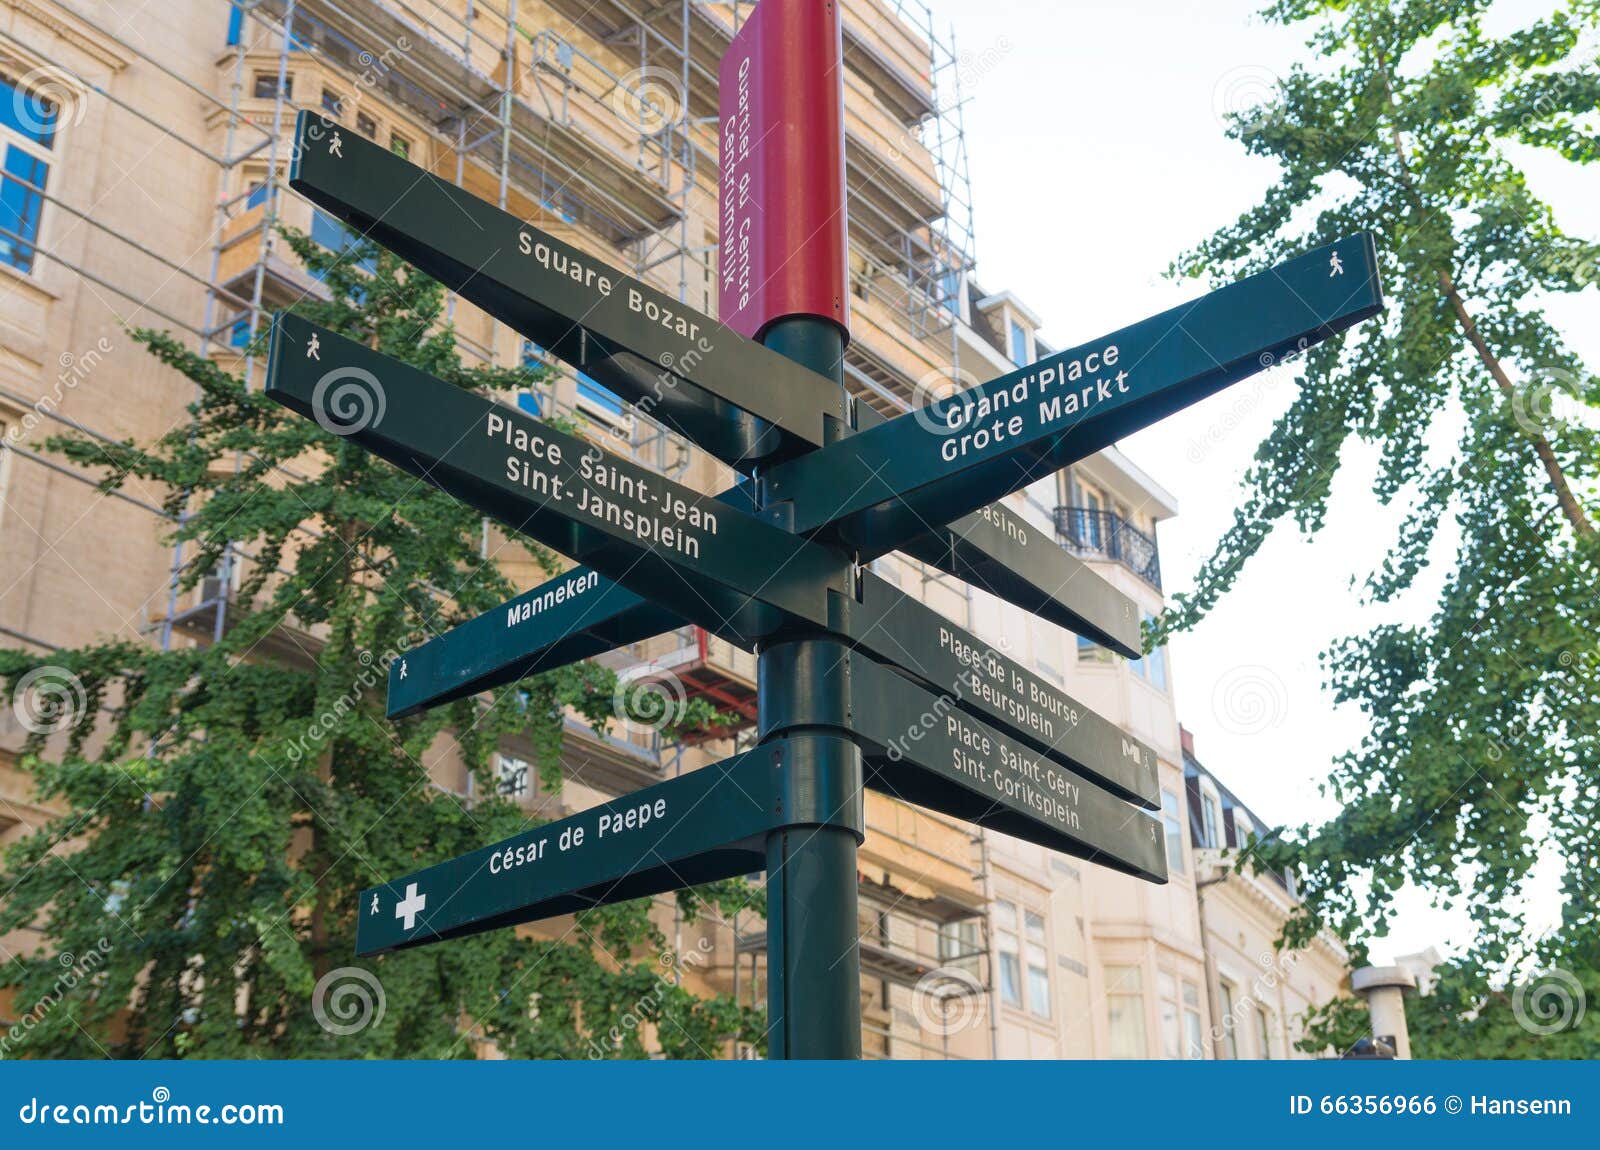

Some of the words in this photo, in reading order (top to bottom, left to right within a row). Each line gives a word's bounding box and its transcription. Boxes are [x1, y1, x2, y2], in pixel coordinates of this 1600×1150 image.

[739, 57, 750, 162] Quartier
[723, 115, 736, 292] Centrumwijk
[739, 172, 751, 209] du
[518, 231, 612, 296] Square
[628, 288, 700, 340] Bozar
[739, 217, 750, 311] Centre
[942, 415, 1023, 462] Grote
[1039, 370, 1130, 425] Markt
[946, 345, 1119, 429] Grand'Place
[487, 412, 562, 465] Place
[580, 455, 717, 535] Saint-Jean
[506, 456, 699, 559] Sint-Jansplein
[976, 505, 1027, 546] asino
[507, 571, 598, 628] Manneken
[939, 627, 981, 668] Place
[988, 658, 1006, 683] de
[1011, 670, 1024, 695] la
[1030, 681, 1078, 726] Bourse
[971, 674, 1053, 738] Beursplein
[947, 715, 990, 757] Place
[1000, 744, 1080, 806] Saint-Géry
[953, 748, 1080, 830] Sint-Goriksplein
[489, 838, 548, 874] César
[559, 826, 584, 851] de
[598, 798, 666, 838] Paepe
